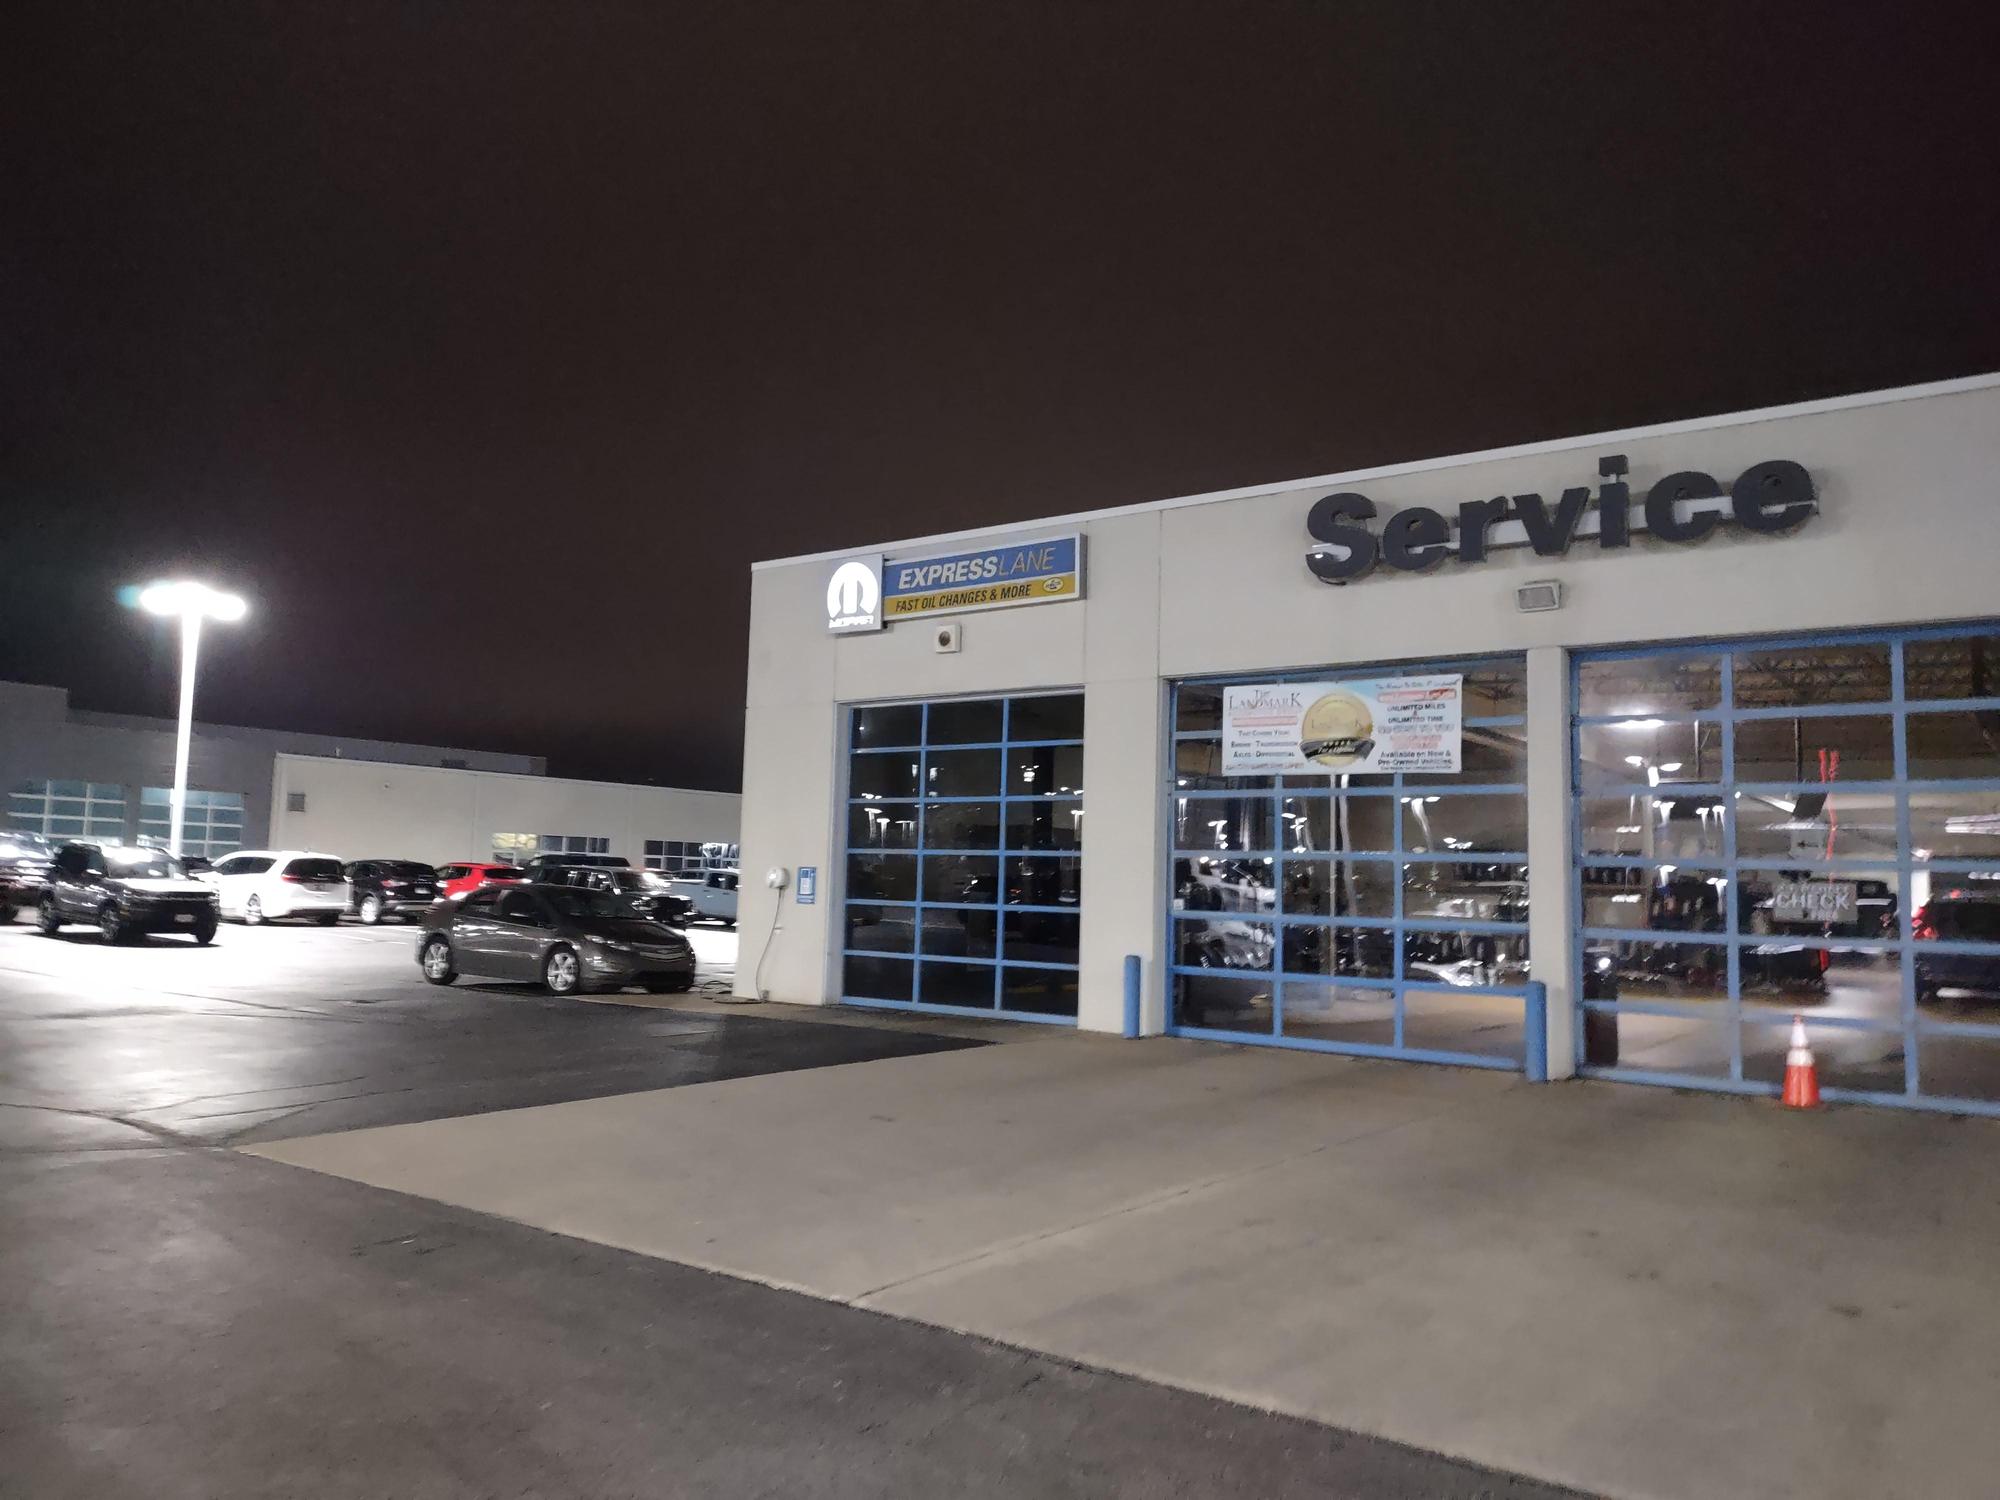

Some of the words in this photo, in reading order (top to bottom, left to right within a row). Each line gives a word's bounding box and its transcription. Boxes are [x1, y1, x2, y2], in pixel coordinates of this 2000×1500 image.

[1306, 455, 1818, 579] Service
[895, 599, 919, 612] FAST
[921, 596, 936, 609] OIL
[939, 589, 987, 607] CHANGES
[990, 589, 998, 601] &
[1000, 584, 1032, 600] MORE
